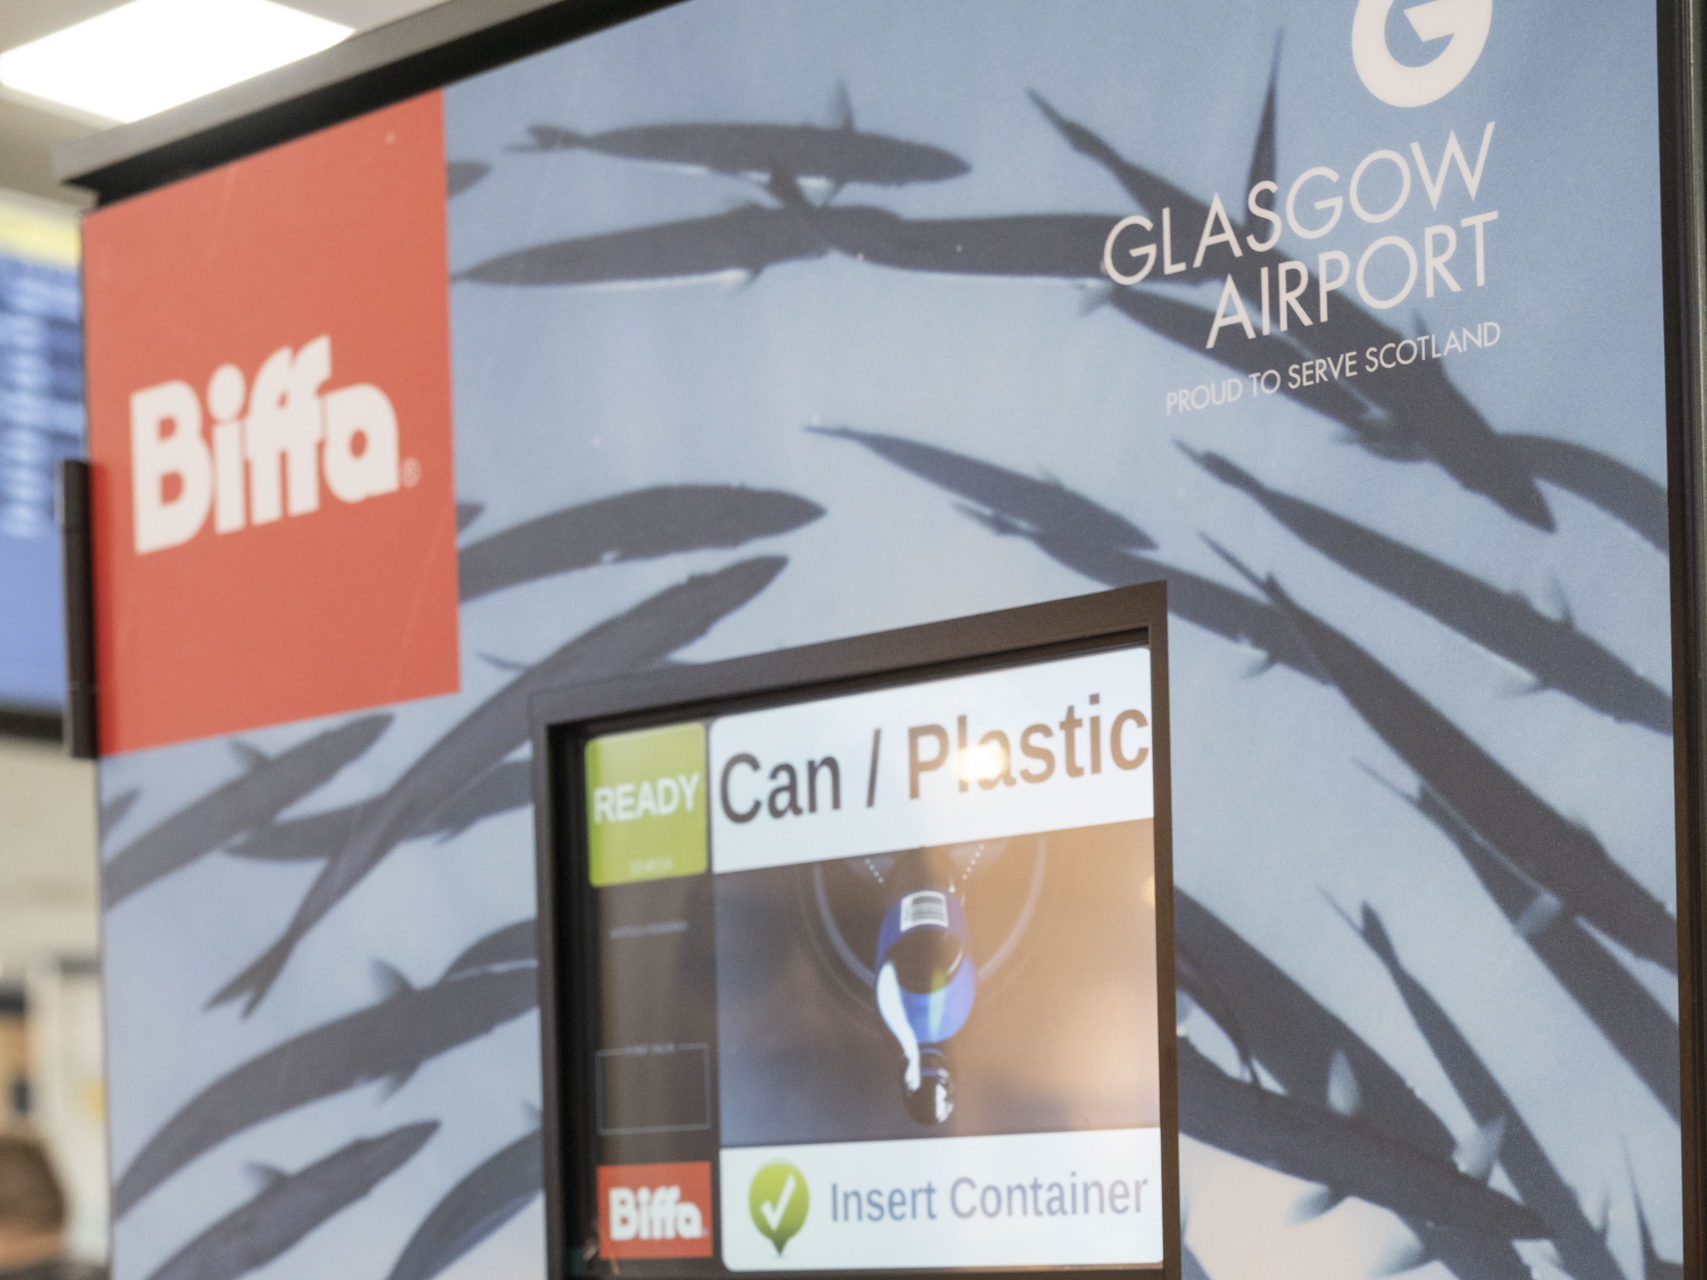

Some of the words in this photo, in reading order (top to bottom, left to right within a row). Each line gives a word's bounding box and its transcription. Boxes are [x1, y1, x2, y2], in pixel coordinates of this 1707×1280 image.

[1352, 0, 1493, 107] G
[1103, 121, 1495, 286] GLASGOW
[1206, 211, 1499, 349] AIRPORT
[1166, 378, 1243, 416] PROUD
[1249, 369, 1281, 397] TO
[1287, 351, 1358, 389] SERVE
[1365, 321, 1501, 373] SCOTLAND
[130, 335, 401, 555] Biffa
[593, 772, 700, 824] READY
[720, 751, 842, 824] Can
[908, 692, 1150, 800] Plastic
[609, 1185, 703, 1241] Biffa
[830, 1179, 937, 1223] Insert
[949, 1171, 1148, 1219] Container
